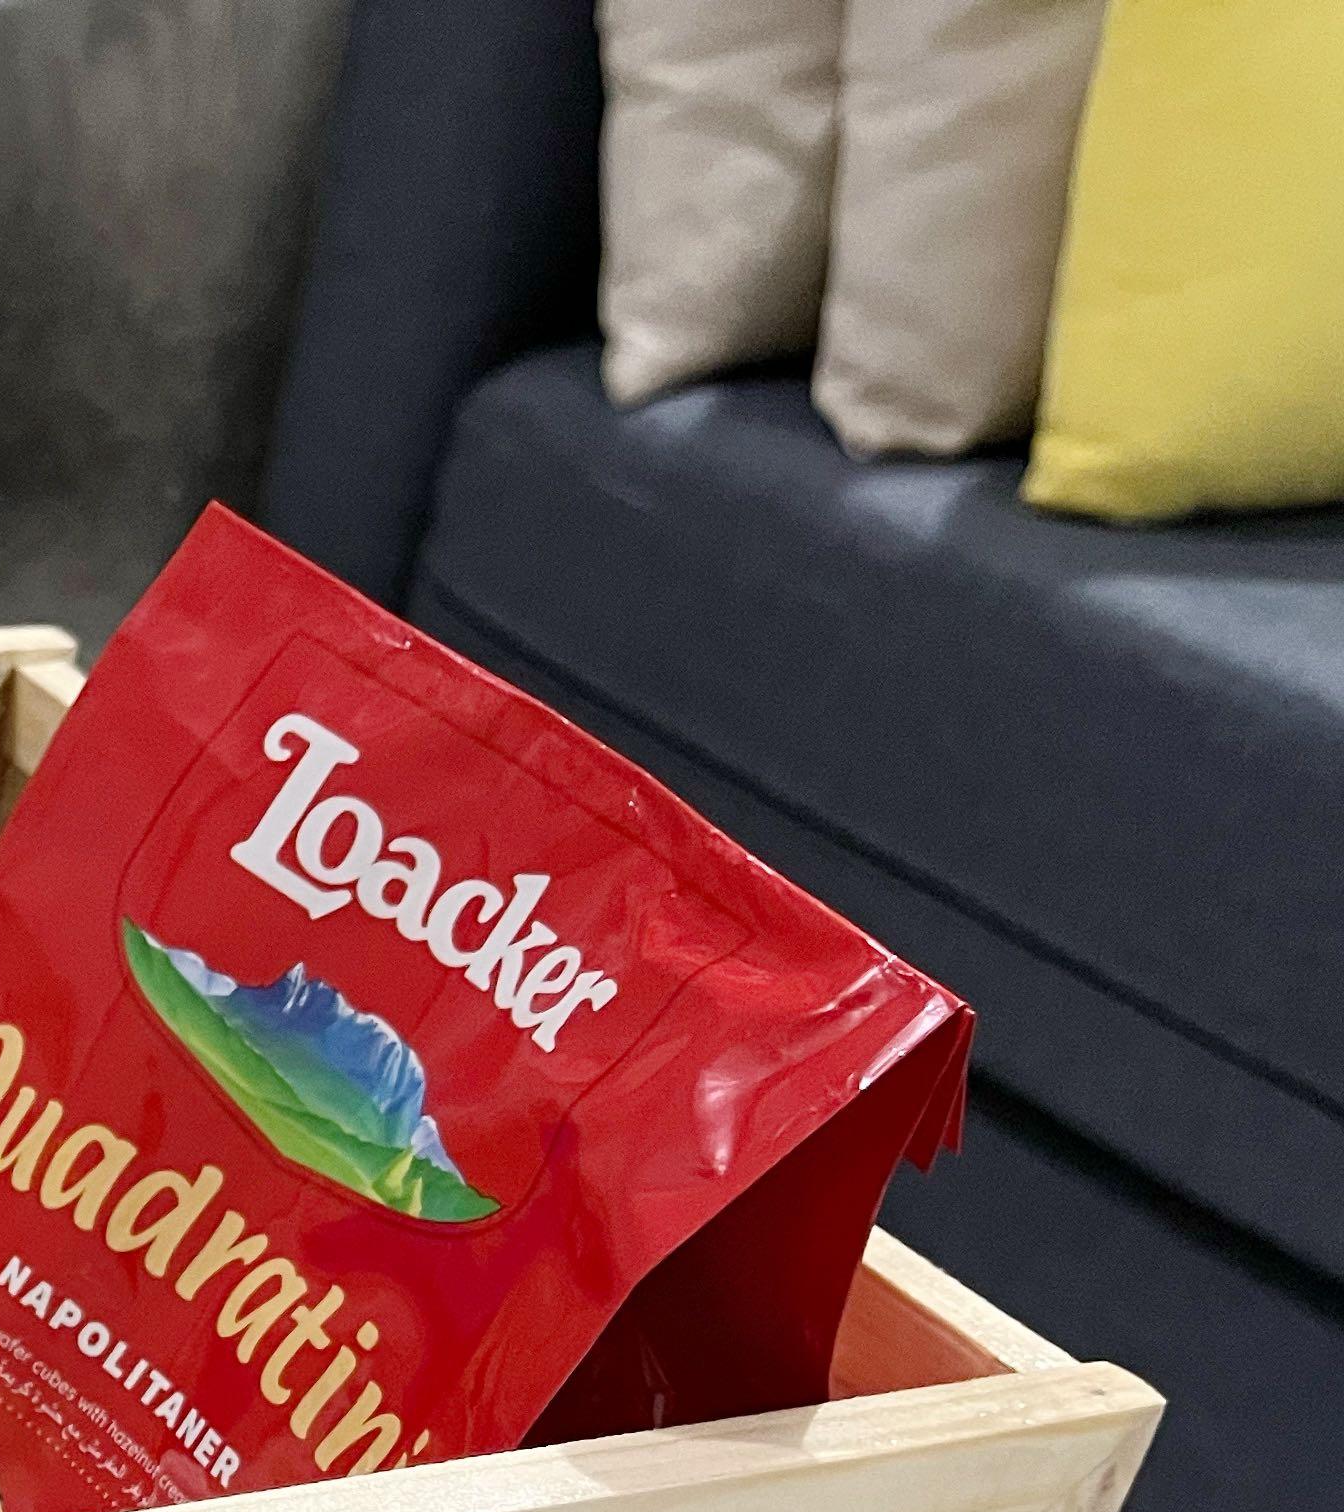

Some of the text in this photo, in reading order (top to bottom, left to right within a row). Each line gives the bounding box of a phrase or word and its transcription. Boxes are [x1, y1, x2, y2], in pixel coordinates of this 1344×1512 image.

[230, 712, 618, 1054] Loacker
[31, 1360, 78, 1401] cubes
[77, 1396, 108, 1428] with
[105, 1420, 162, 1476] hazelnut
